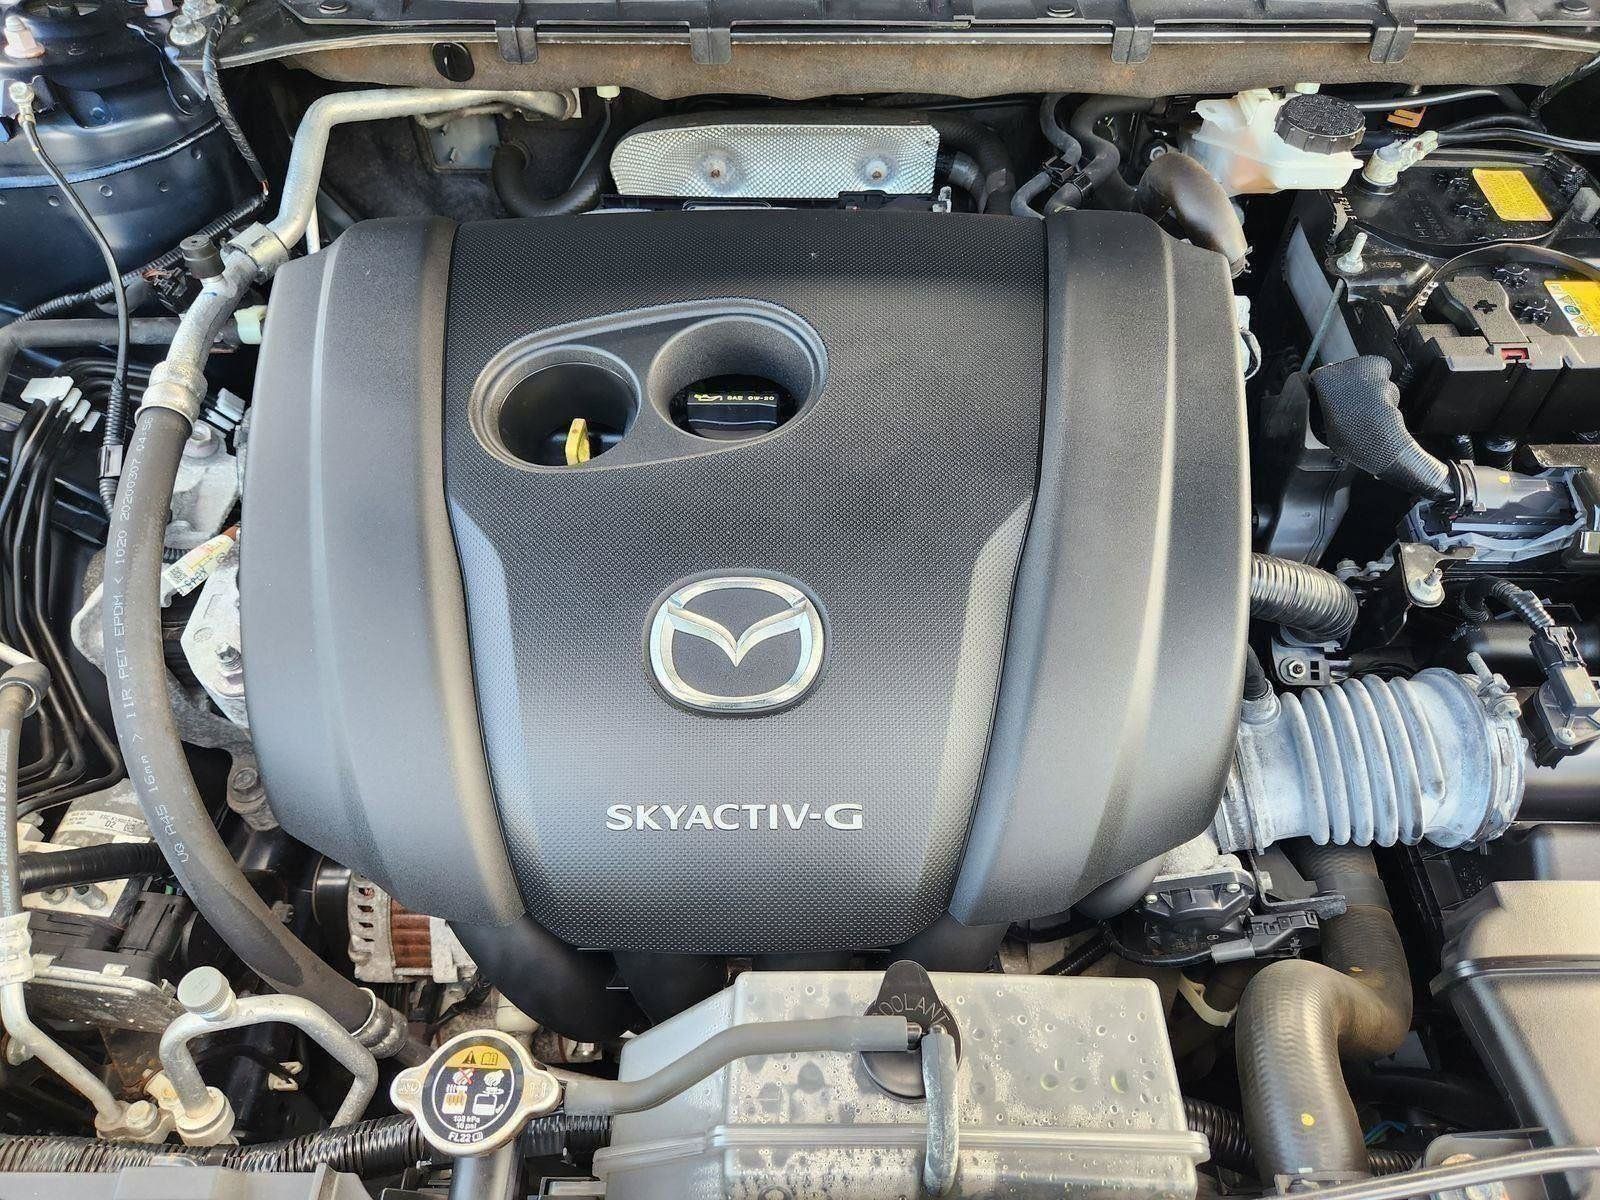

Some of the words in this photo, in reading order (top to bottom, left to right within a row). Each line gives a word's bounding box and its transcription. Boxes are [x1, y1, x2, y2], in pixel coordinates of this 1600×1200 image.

[119, 457, 142, 521] 20200307
[114, 529, 127, 565] 1020
[112, 593, 125, 637] EPDM
[115, 646, 130, 679] PET
[140, 753, 159, 794] 16mm
[154, 803, 177, 836] A45
[605, 803, 863, 831] SKYACTIV-G
[871, 992, 950, 1024] OOLANT
[447, 1131, 472, 1143] FL22
